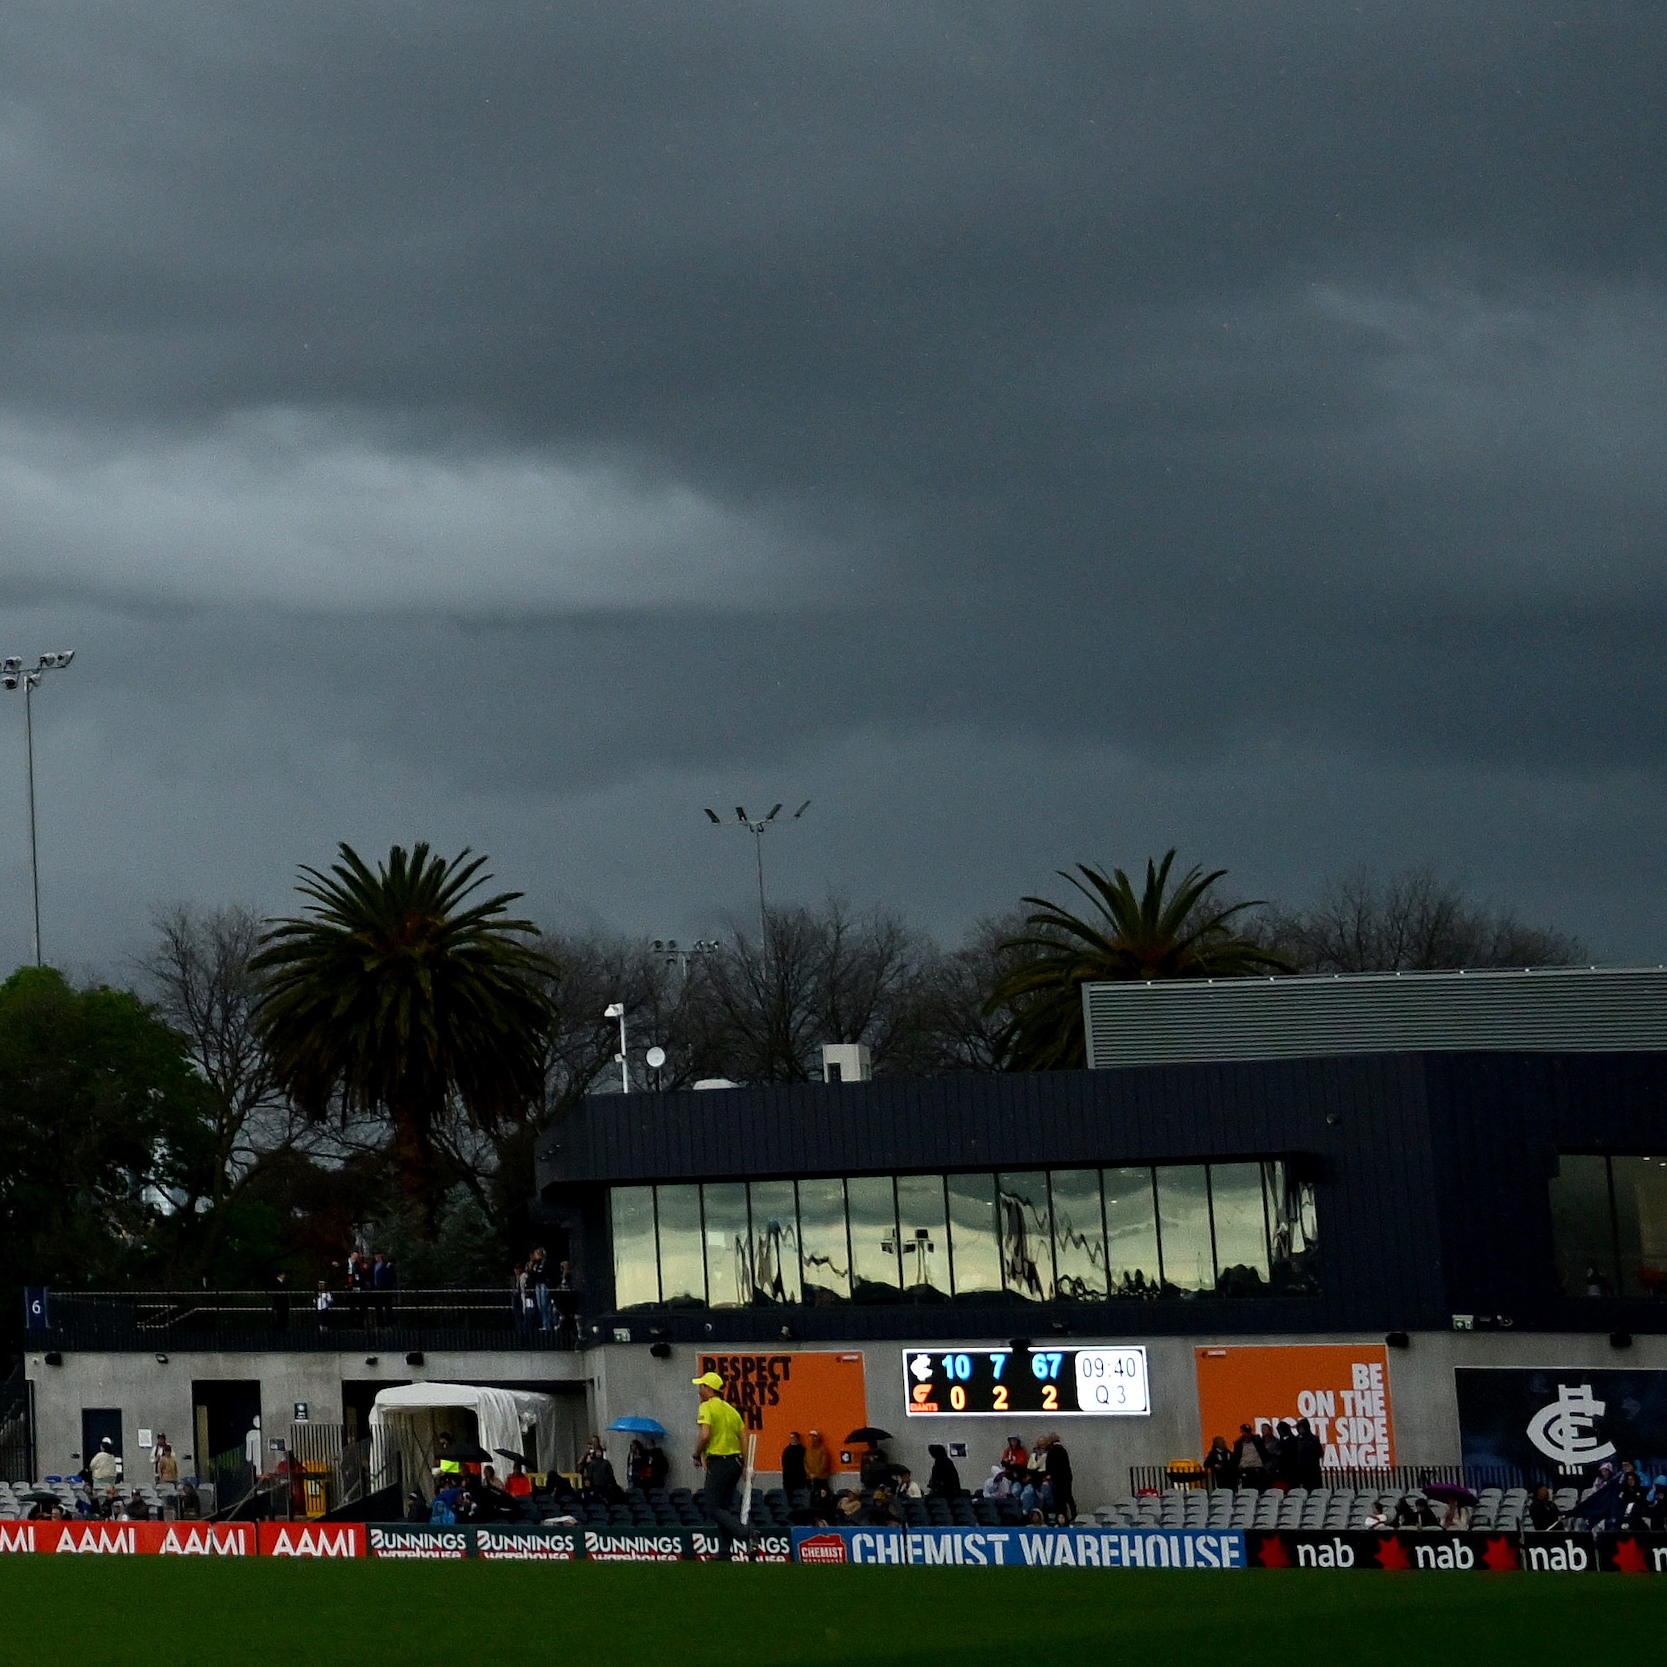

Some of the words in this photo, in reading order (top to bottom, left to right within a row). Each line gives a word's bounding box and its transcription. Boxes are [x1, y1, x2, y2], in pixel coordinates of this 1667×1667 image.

[32, 1299, 41, 1314] 6
[942, 1354, 970, 1380] 10
[990, 1354, 1006, 1380] 7
[1032, 1353, 1063, 1380] 67
[1083, 1357, 1136, 1378] 09:40
[1352, 1362, 1383, 1390] BE
[950, 1385, 965, 1410] 0
[993, 1385, 1009, 1410] 2
[1042, 1385, 1058, 1410] 2
[1095, 1385, 1110, 1405] Q
[1117, 1386, 1125, 1404] 3
[1297, 1390, 1336, 1418] ON
[1340, 1390, 1385, 1418] THE
[1334, 1417, 1388, 1445] SIDE
[56, 1527, 135, 1554] AAMI
[161, 1528, 245, 1555] AAMI
[272, 1530, 354, 1556] AAMI
[370, 1530, 466, 1551] BUNNINGS
[477, 1530, 574, 1552] BUNNINGS
[585, 1532, 682, 1554] BUNNINGS
[801, 1547, 844, 1559] CHEMIST
[852, 1534, 1010, 1565] CHEMIST
[1019, 1535, 1239, 1566] WAREHOUSE
[1298, 1540, 1353, 1566] nab
[1416, 1539, 1474, 1569] nab
[1530, 1540, 1587, 1571] nab
